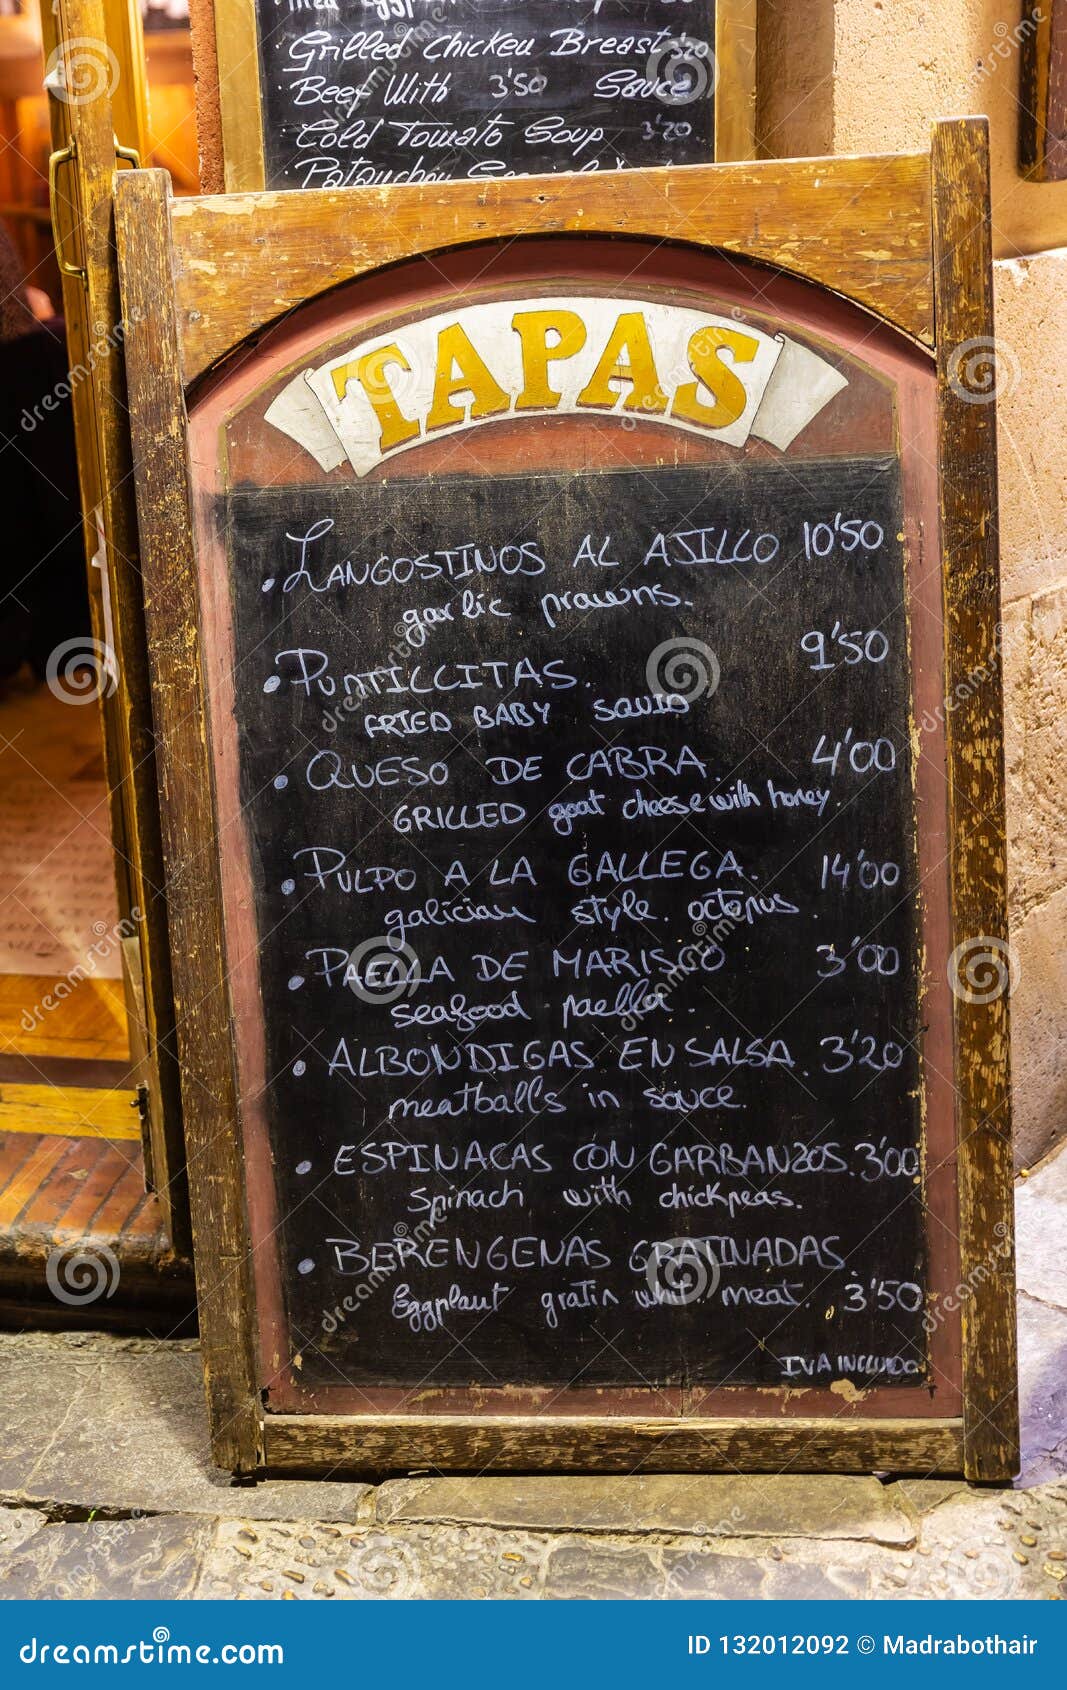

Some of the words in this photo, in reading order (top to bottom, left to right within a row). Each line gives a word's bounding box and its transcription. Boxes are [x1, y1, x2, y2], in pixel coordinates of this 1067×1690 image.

[283, 28, 414, 71] Grilled
[549, 25, 672, 56] Breast
[290, 69, 376, 118] Beef
[384, 72, 452, 106] With
[594, 69, 692, 98] Sauce
[296, 118, 385, 149] Cold
[389, 113, 515, 148] Tomato
[525, 116, 604, 156] Soup
[331, 310, 761, 453] TAPAS
[282, 518, 546, 592] LANGOSTINOS
[572, 534, 619, 567] AL
[643, 527, 780, 565] AJILLO
[804, 512, 885, 560] 10'50
[801, 621, 889, 670] 9'50
[364, 709, 451, 738] FRIED
[473, 702, 551, 729] BABY
[593, 693, 690, 722] SQUID
[306, 750, 449, 790] QUESO
[485, 756, 543, 785] DE
[812, 728, 896, 776] 4'00
[393, 803, 526, 833] GRILLED
[548, 788, 605, 836] goat
[622, 789, 706, 820] cheese
[709, 779, 761, 810] with
[293, 847, 417, 893] PULPO
[444, 860, 470, 886] A
[489, 856, 538, 886] LA
[821, 849, 899, 889] 14'00
[305, 948, 456, 990] PAELLA
[472, 951, 529, 982] DE
[553, 948, 726, 979] MARISCO
[816, 936, 899, 977] 3'00
[391, 990, 532, 1031] seafood
[329, 1037, 595, 1077] ALBONDIGAS
[619, 1037, 675, 1070] EN
[820, 1029, 904, 1073] 3'20
[389, 1075, 567, 1119] meatballs
[583, 1083, 620, 1108] in
[334, 1140, 553, 1174] ESPINACAS
[573, 1140, 634, 1170] CON
[855, 1136, 919, 1182] 3'00
[563, 1176, 632, 1206] with
[325, 1236, 611, 1275] BERENGENAS
[541, 1280, 619, 1329] gratin
[844, 1278, 923, 1312] 3'50
[780, 1352, 832, 1376] IVA
